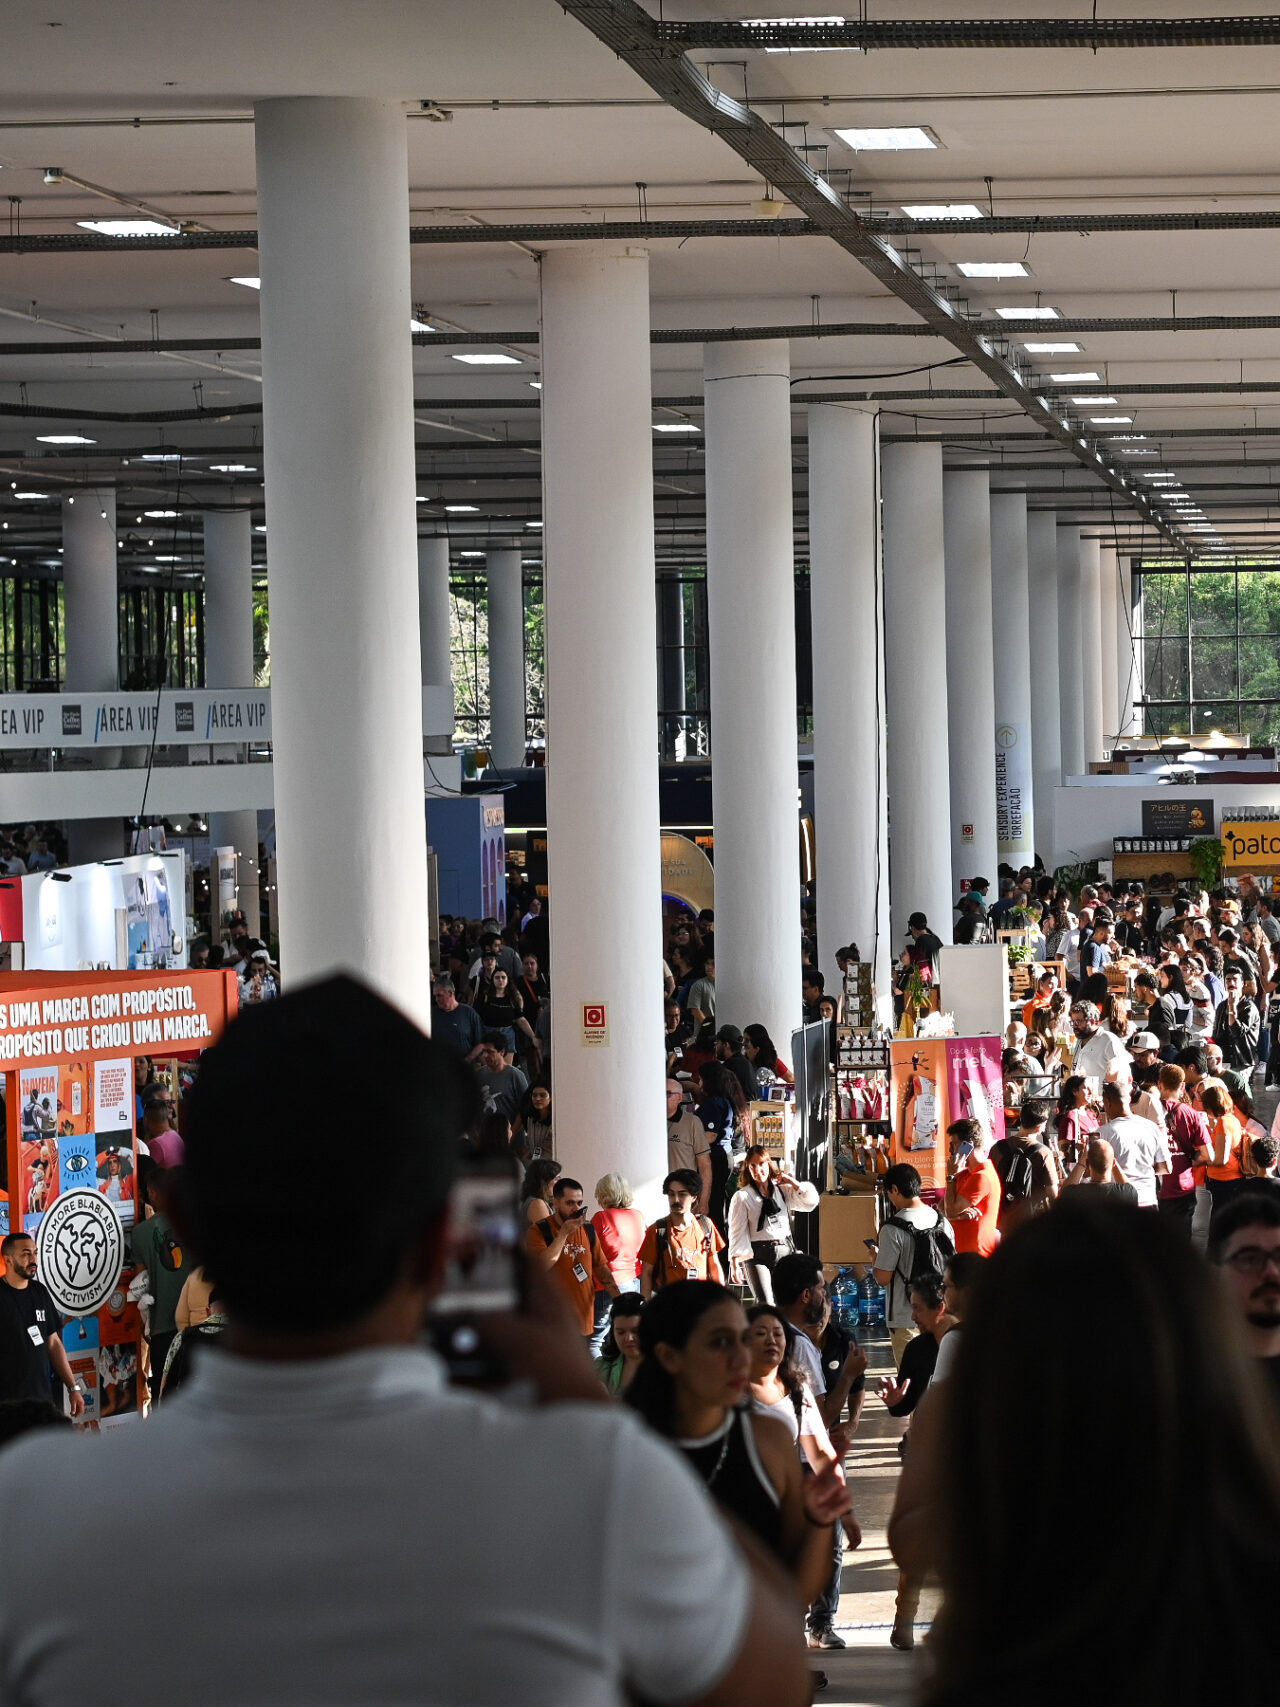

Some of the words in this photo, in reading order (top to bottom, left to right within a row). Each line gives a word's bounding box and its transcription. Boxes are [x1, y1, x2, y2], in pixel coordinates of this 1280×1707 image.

[23, 708, 45, 733] VIP
[100, 704, 133, 731] ÁREA
[211, 702, 242, 728] ÁREA
[249, 703, 266, 727] VIP
[995, 752, 1007, 801] EXPERIENCE
[997, 805, 1009, 841] SENSORY
[1009, 788, 1022, 841] TORREFAÇÃO
[9, 1001, 41, 1028] UMA
[43, 996, 89, 1024] MARCA
[91, 993, 120, 1019] COM
[122, 985, 196, 1017] PROPÓSITO,
[64, 1025, 90, 1054] QUE
[91, 1022, 131, 1050] CRIOU
[133, 1018, 162, 1045] UMA
[163, 1013, 212, 1042] MARCA.
[952, 1050, 987, 1069] mel
[45, 1232, 54, 1253] NO
[51, 1201, 76, 1231] MORE
[78, 1199, 116, 1247] BLABLABLA
[60, 1284, 102, 1303] ACTIVISM
